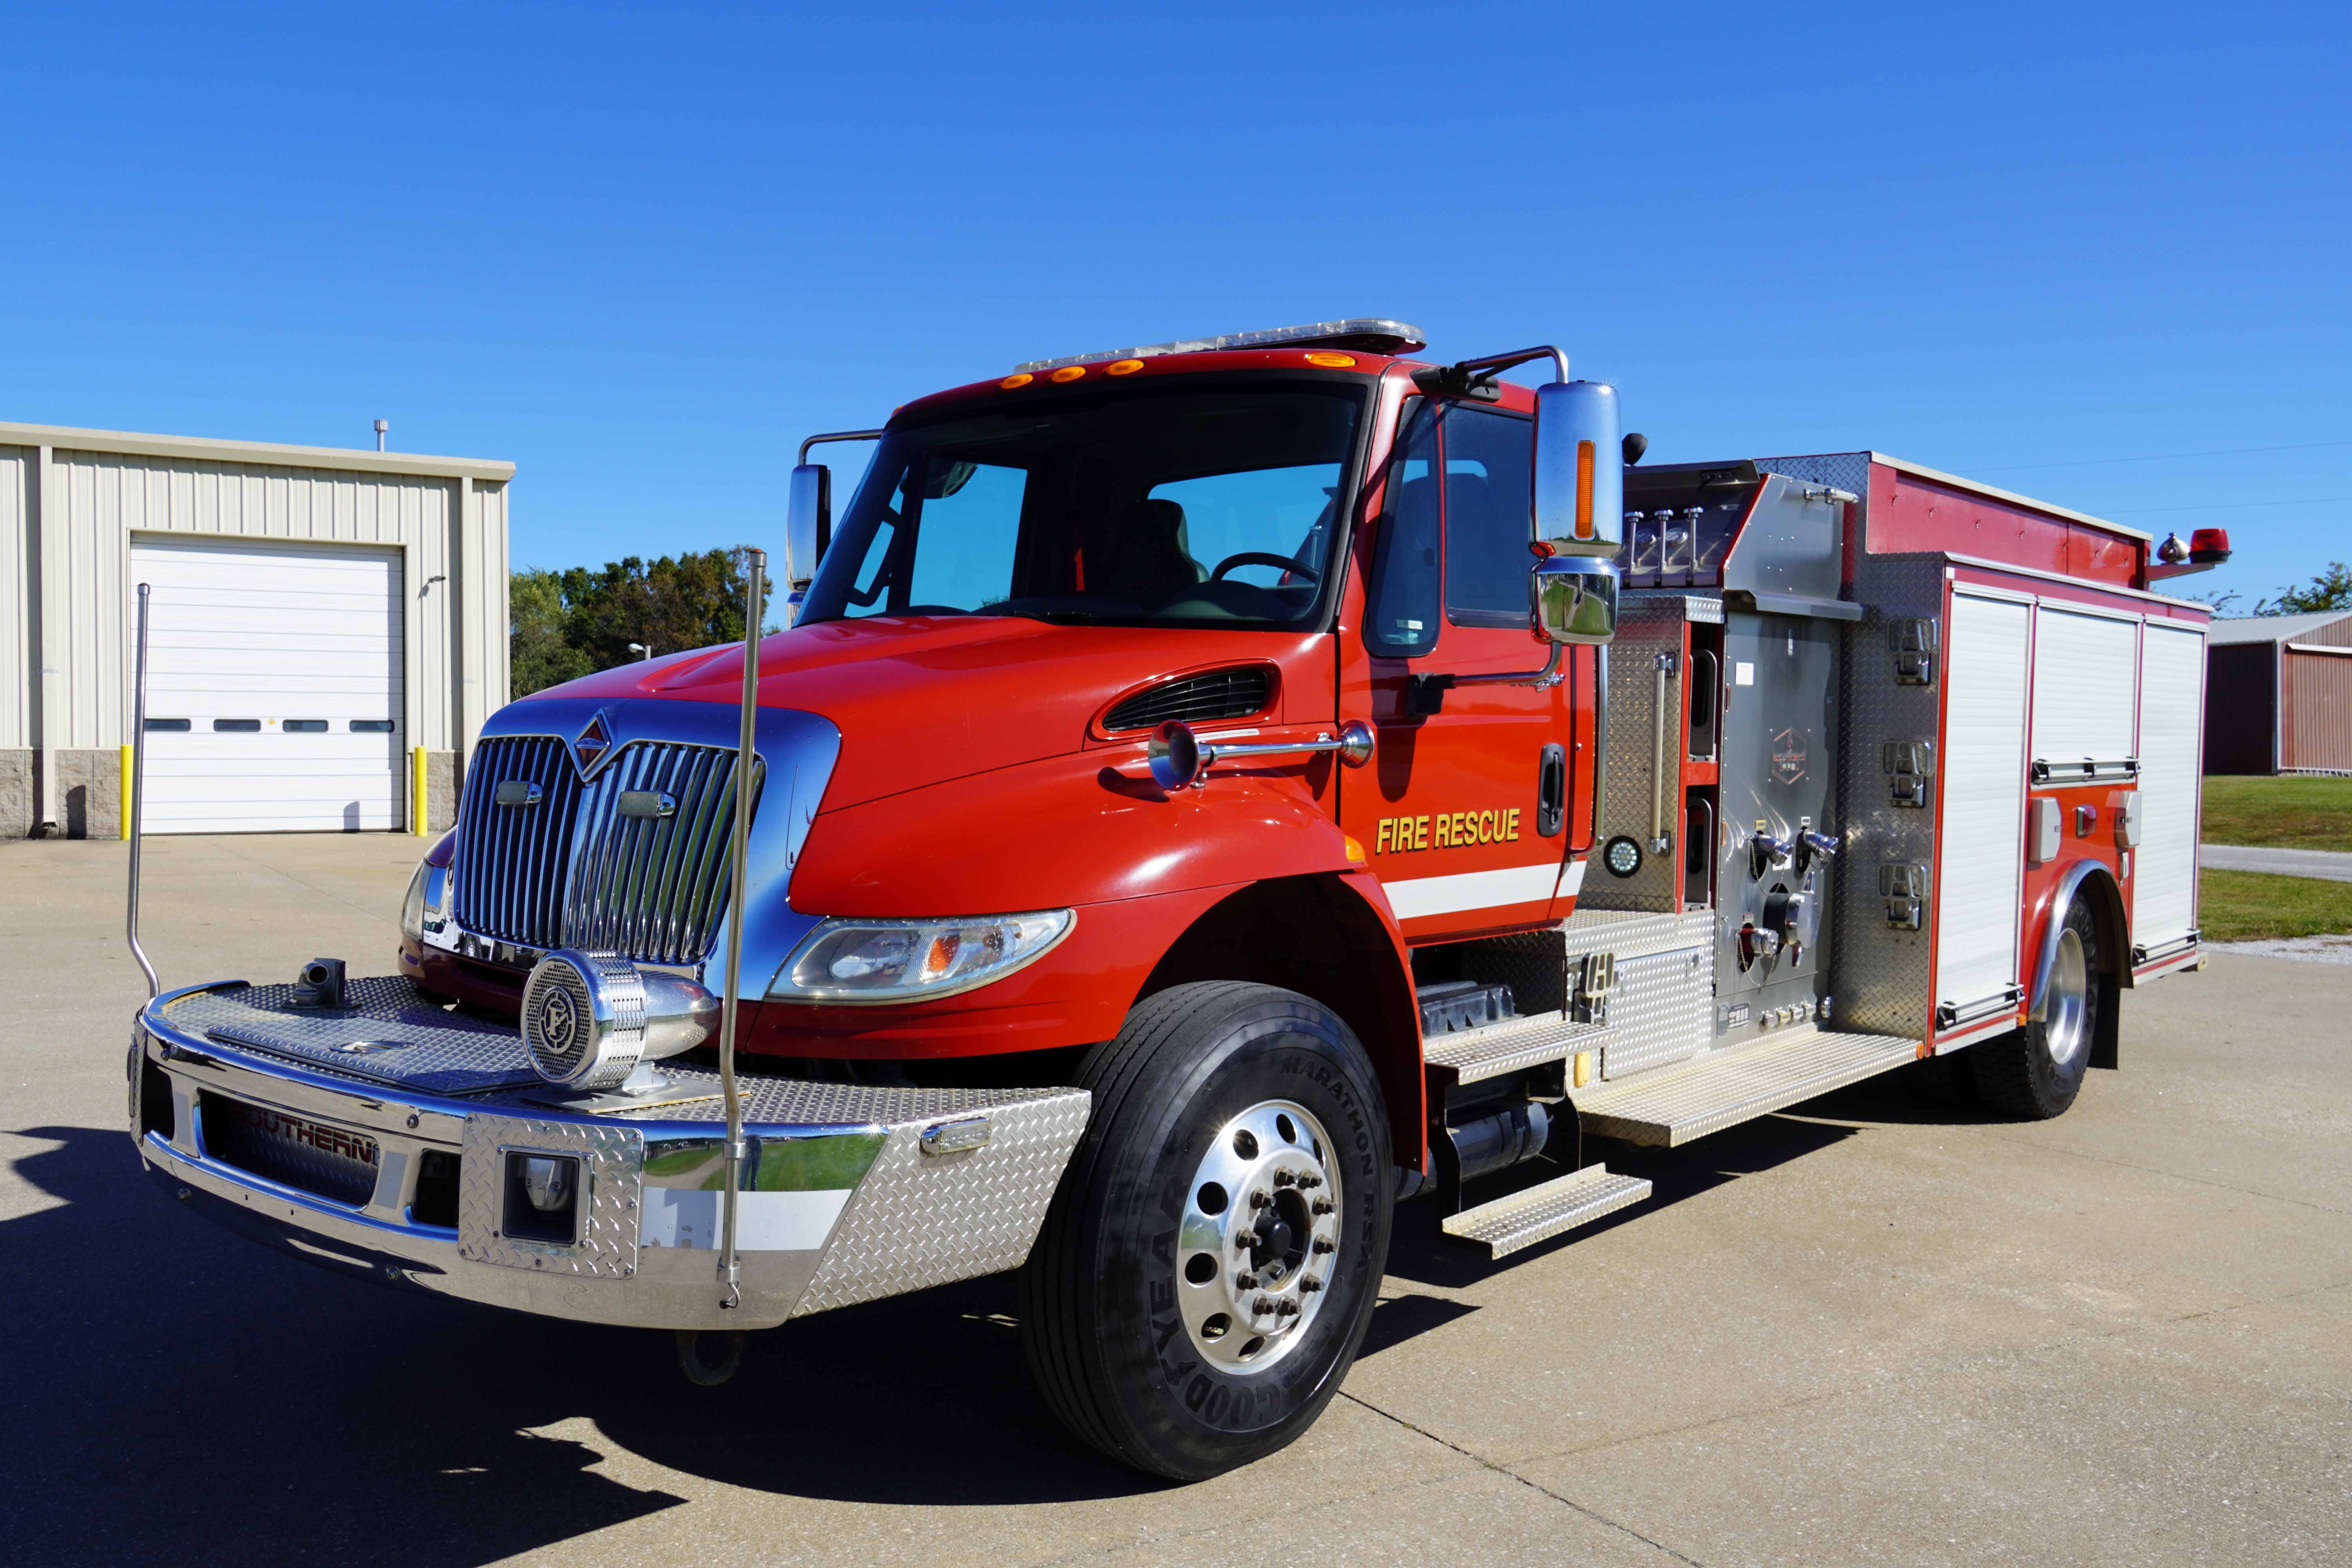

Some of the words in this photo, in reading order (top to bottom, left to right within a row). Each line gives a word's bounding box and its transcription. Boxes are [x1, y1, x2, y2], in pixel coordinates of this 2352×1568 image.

[1375, 815, 1430, 855] FIRE
[1433, 808, 1520, 850] RESCUE
[1280, 1057, 1373, 1177] MARATHON
[1357, 1192, 1374, 1270] RSA
[1150, 1174, 1282, 1429] GOODYEAR
